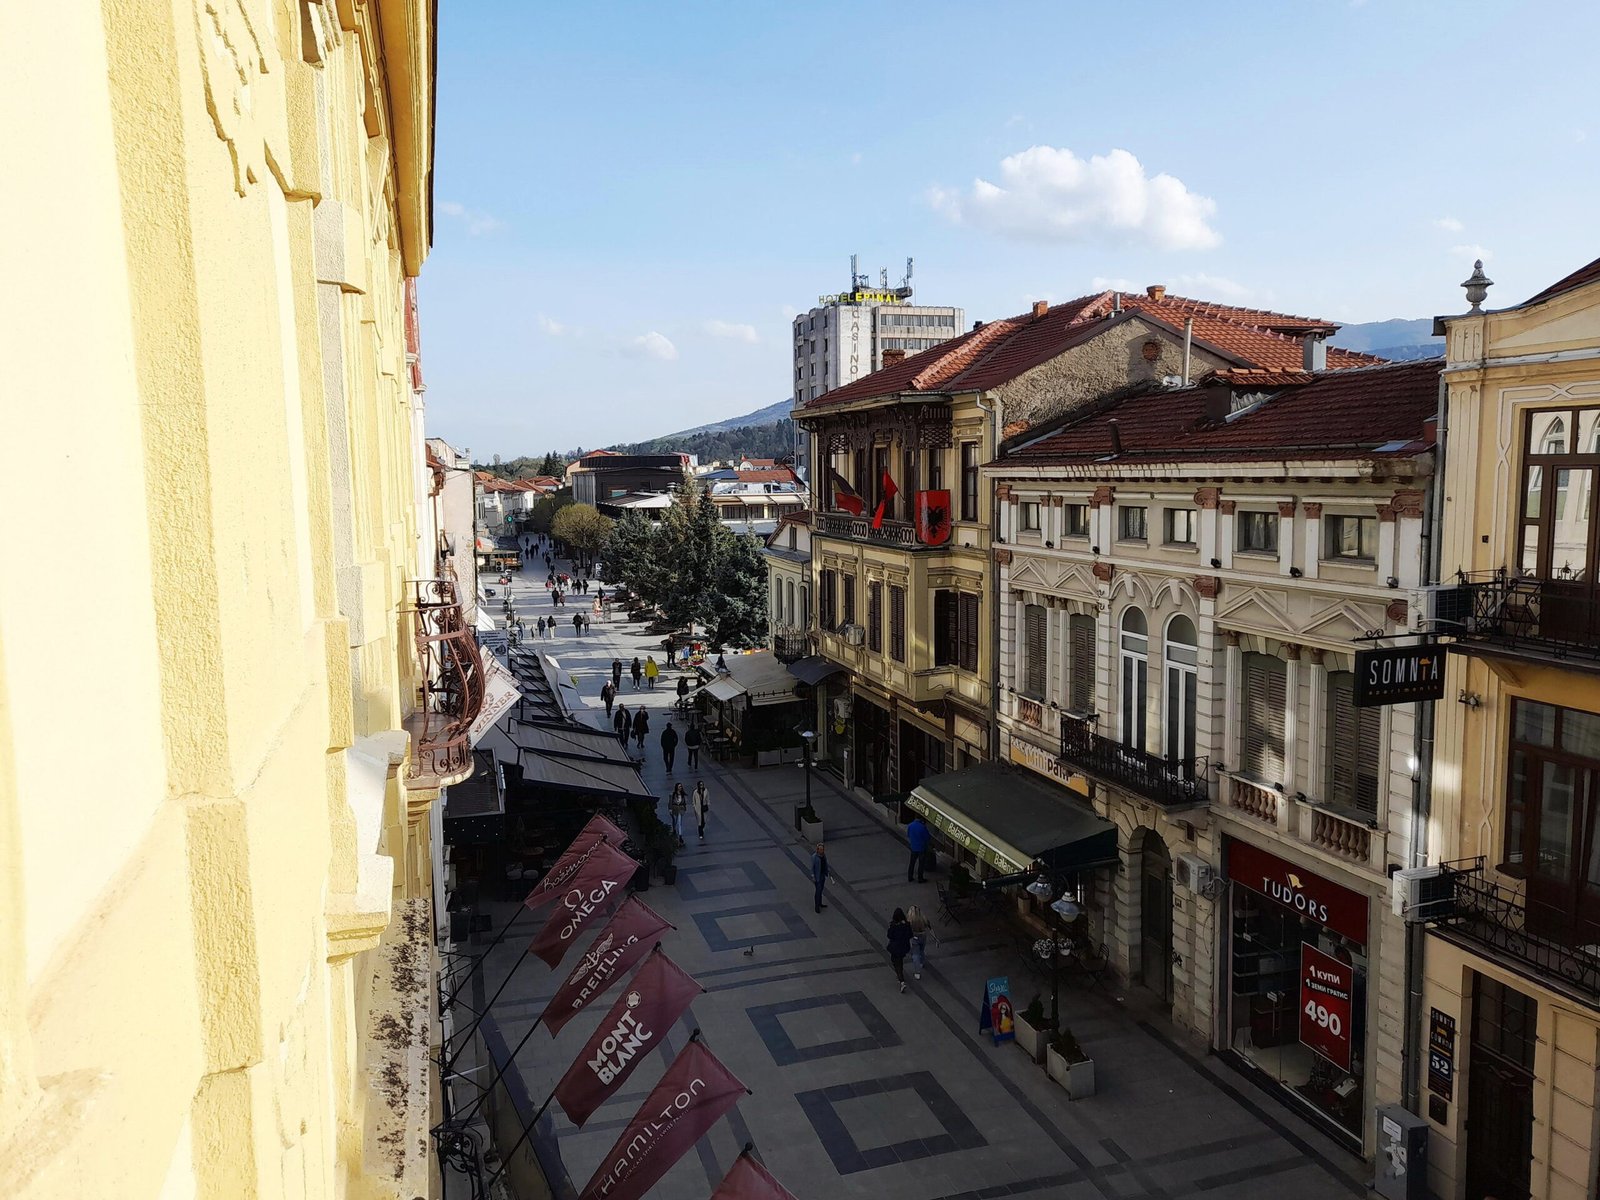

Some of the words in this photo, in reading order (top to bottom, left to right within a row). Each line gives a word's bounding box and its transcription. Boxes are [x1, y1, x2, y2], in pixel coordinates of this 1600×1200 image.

[818, 294, 854, 305] HOTEL
[855, 292, 901, 304] EPINAL
[850, 311, 860, 375] CASINO
[474, 690, 515, 734] WINNER
[907, 796, 926, 813] Balans
[947, 822, 967, 842] Balans
[560, 879, 618, 940] OMEGA
[1262, 876, 1329, 922] TUDORS
[1309, 965, 1316, 978] 1
[1317, 970, 1341, 985] КУПИ
[1311, 982, 1327, 992] ЗЕМИ
[1326, 986, 1349, 1000] ГРАТИС
[1304, 999, 1342, 1036] 490
[586, 1009, 641, 1074] MONT
[597, 1021, 653, 1086] BLANC
[1431, 1055, 1449, 1075] 52
[599, 1078, 706, 1196] HAMILTON
